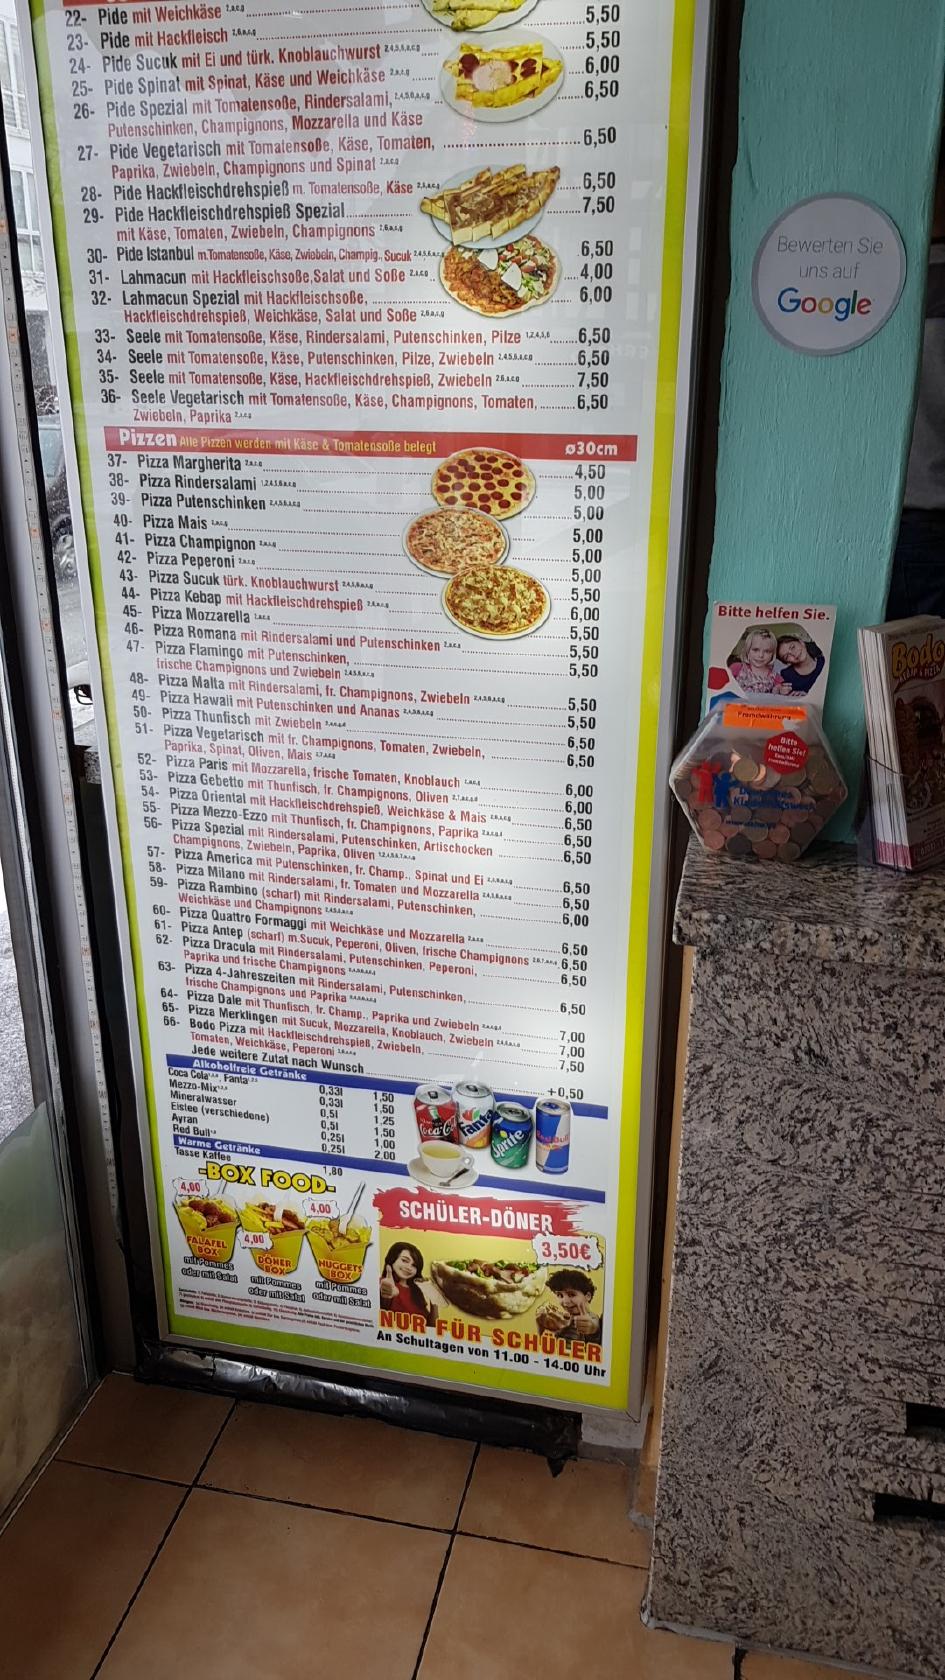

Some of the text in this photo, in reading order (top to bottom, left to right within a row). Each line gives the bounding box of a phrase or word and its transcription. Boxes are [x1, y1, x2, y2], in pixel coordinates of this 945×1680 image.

[65, 12, 86, 26] 22-
[98, 9, 128, 26] Pide
[132, 7, 151, 23] mit
[156, 4, 221, 22] Weichkäse
[586, 5, 620, 24] 5,50
[67, 35, 88, 50] 23-
[101, 31, 130, 49] Pide
[135, 30, 153, 46] mit
[157, 28, 228, 45] Hackfleisch
[586, 30, 620, 49] 5,50
[69, 58, 90, 74] 24-
[103, 55, 132, 72] Pide
[136, 54, 177, 70] Sucuk
[182, 52, 200, 68] mit
[205, 52, 216, 67] Ei
[221, 50, 242, 66] und
[247, 48, 274, 65] türk.
[279, 43, 381, 64] Knoblauchwurst
[585, 56, 620, 74] 6,00
[78, 127, 616, 161] 27- Pide Vegetarisch mit Tomatensoße, Käse, Tomaten, 6,50
[83, 196, 615, 223] 29- Pide Hackfleischdrehspieß Spezial 7,50
[777, 235, 883, 254] Bewerten Sie
[799, 263, 860, 279] uns auf
[91, 286, 612, 309] 32- Lahmacun Spezial mit Hackfleischsoße, 6,00
[777, 287, 871, 321] Google
[95, 327, 610, 347] 33- Seele mit Tomatensoße, Käse, Rindersalami, Putenschinken, Pilze 6,50
[119, 428, 177, 447] Pizzen
[180, 434, 198, 448] Alle
[201, 436, 232, 448] Pizzen
[235, 436, 272, 449] werden
[275, 437, 291, 449] mit
[293, 437, 319, 451] Käse
[334, 438, 401, 453] Tomatensoße
[404, 441, 436, 454] belegt
[565, 441, 618, 456] ø30cm
[108, 454, 606, 482] 37- Pizza Margherita 4,50
[115, 533, 602, 565] 41- Pizza Champignon 5,00
[119, 569, 600, 604] 43- Pizza Sucuk türk. Knoblauchwurst 5,50
[718, 605, 830, 620] Bitte helfen Sie.
[133, 706, 595, 752] 50- Pizza Thunfisch mit Zwiebeln 6,50
[153, 905, 588, 958] 60- Pizza Quattro Formaggi mit Weichkäse und Mozzarella 6,50
[192, 1045, 364, 1074] Jede weitere Zutat nach Wunsch
[193, 1058, 308, 1081] Alkoholfreie Getränke
[170, 1090, 395, 1126] Mineralwasser 0,5l 1,25
[548, 1087, 584, 1102] +0,50
[171, 1102, 395, 1138] Eistee (verschiedene) 0,5l 1,50
[458, 1109, 494, 1137] Fanta
[178, 1136, 261, 1155] Warme Getränke
[492, 1129, 524, 1158] Sprite
[175, 1147, 343, 1177] Tasse Kaffee 1,80
[199, 1161, 336, 1194] -BOX FOOD-
[399, 1200, 553, 1233] SCHÜLER-DÖNER
[542, 1241, 591, 1261] 3,50€
[380, 1310, 602, 1363] NUR FÜR SCHÜLER
[377, 1330, 606, 1377] An Schultagen von 11.00 14.00 Uhr
